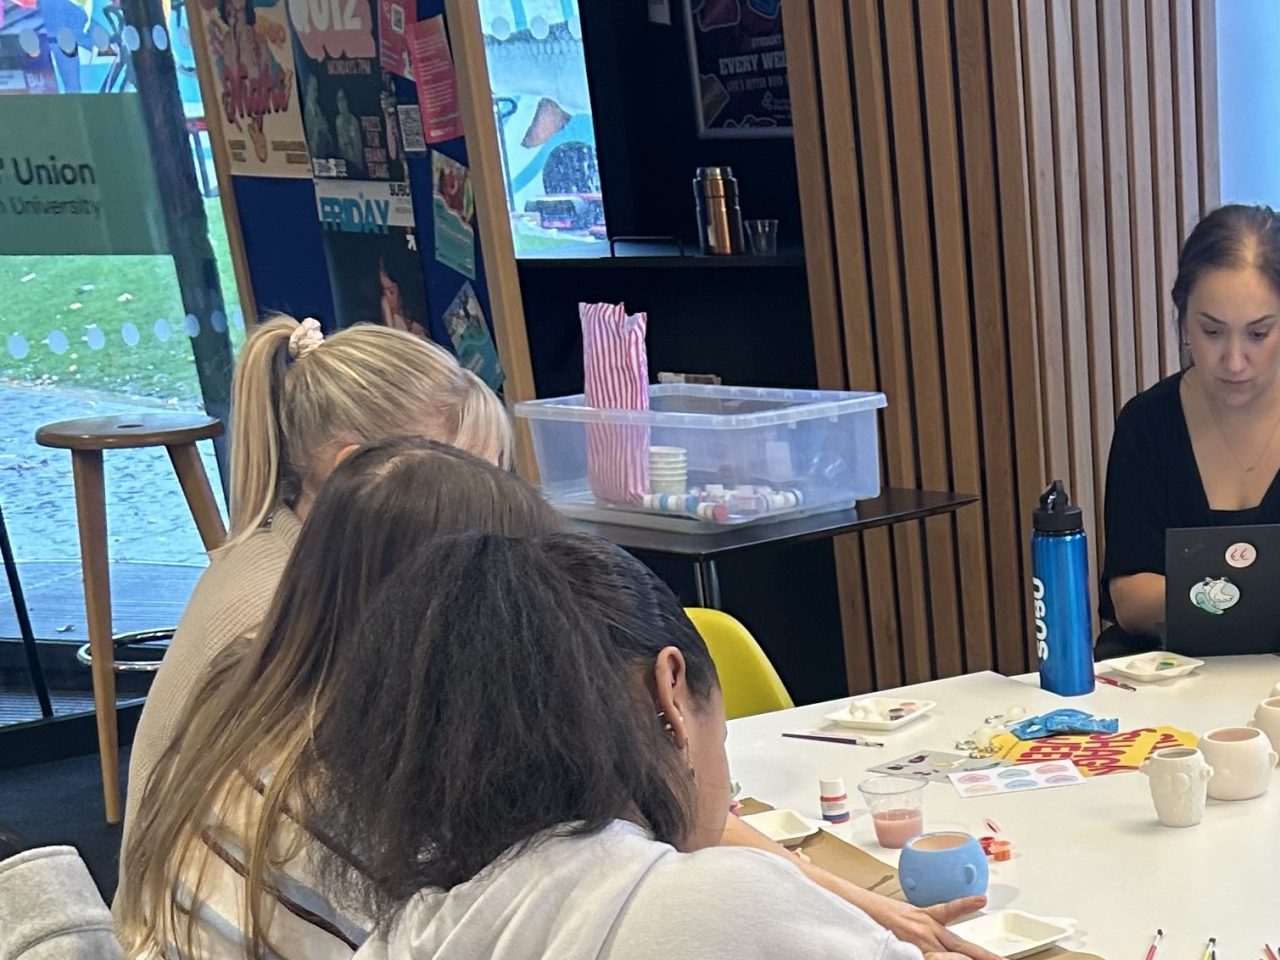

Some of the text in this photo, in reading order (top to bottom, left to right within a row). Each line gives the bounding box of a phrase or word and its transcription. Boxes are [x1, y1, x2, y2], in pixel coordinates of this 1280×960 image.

[719, 54, 758, 75] EVERY
[11, 154, 96, 186] Union
[320, 197, 390, 235] FRIDAY
[1032, 576, 1049, 661] SUBU
